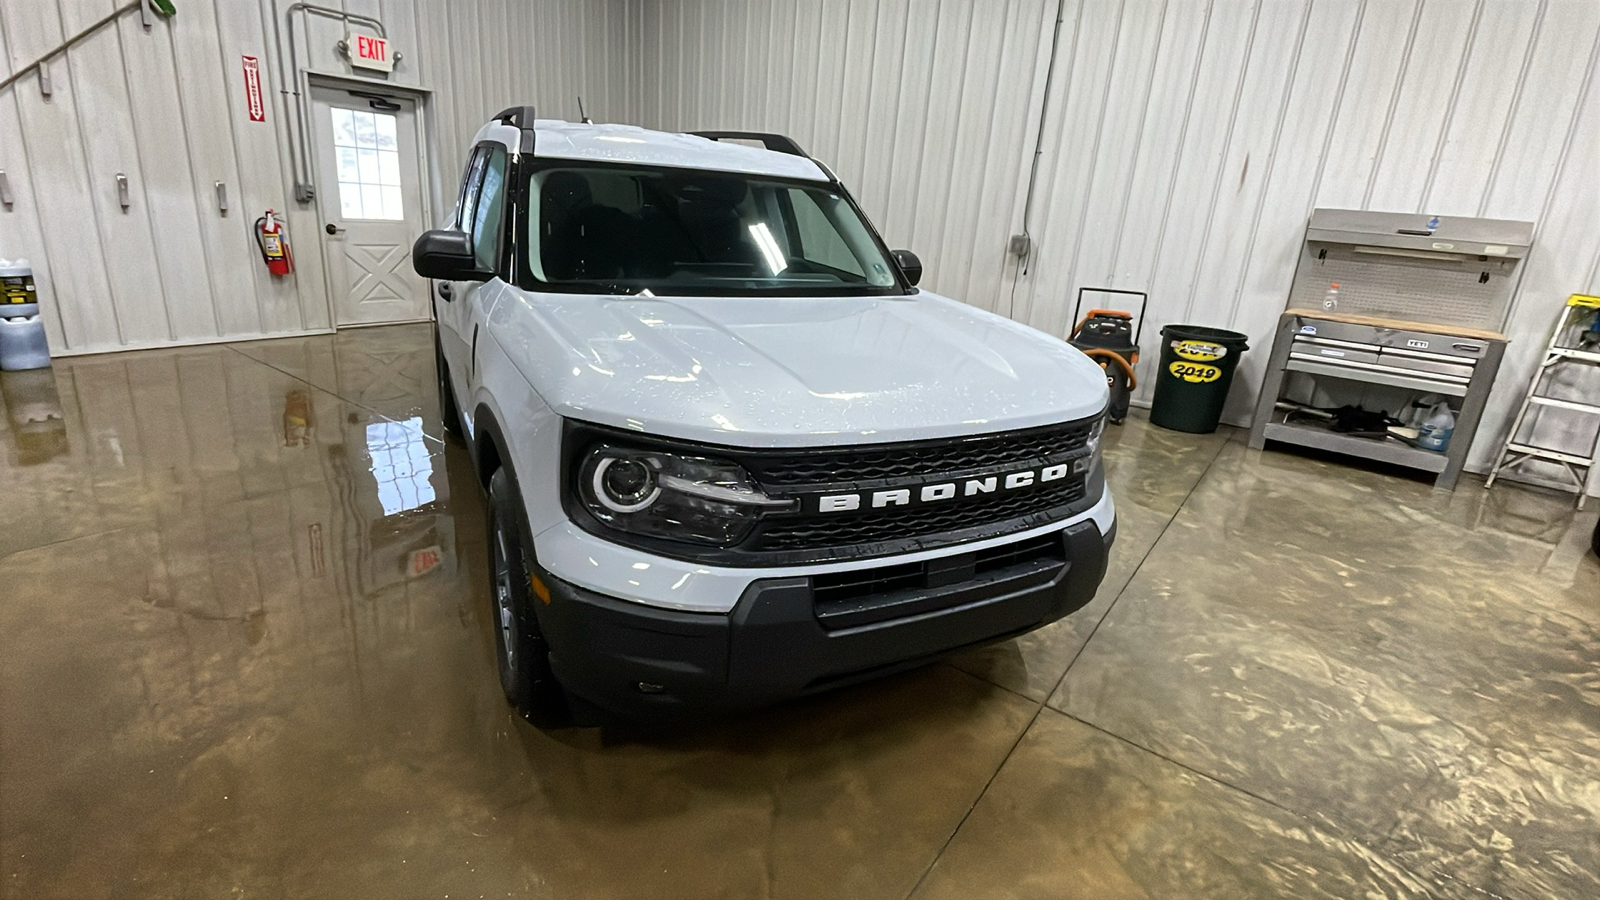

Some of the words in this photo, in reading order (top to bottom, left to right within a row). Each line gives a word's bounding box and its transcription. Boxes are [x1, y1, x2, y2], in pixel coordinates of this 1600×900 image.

[358, 36, 386, 62] EXIT
[1174, 364, 1216, 379] 2019
[819, 463, 1068, 513] BRONCO
